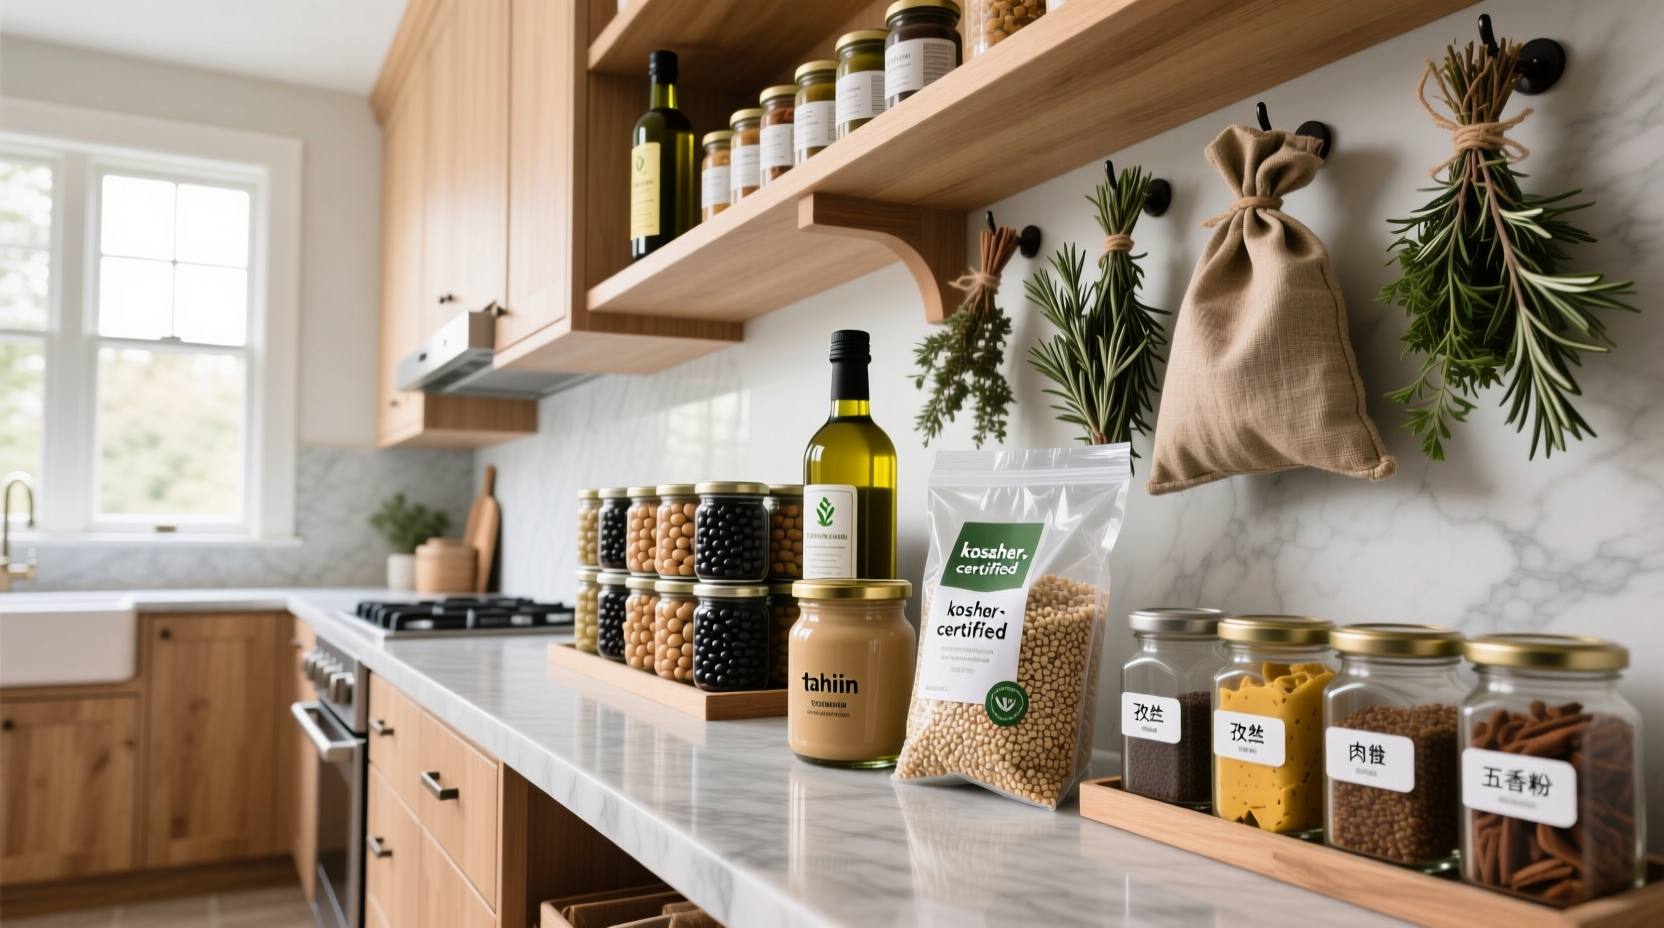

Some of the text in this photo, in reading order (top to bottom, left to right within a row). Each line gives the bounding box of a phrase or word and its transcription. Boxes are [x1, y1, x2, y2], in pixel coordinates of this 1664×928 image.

[937, 621, 1007, 640] certified
[802, 672, 858, 694] tahiin
[1481, 766, 1554, 797] 五香粉
